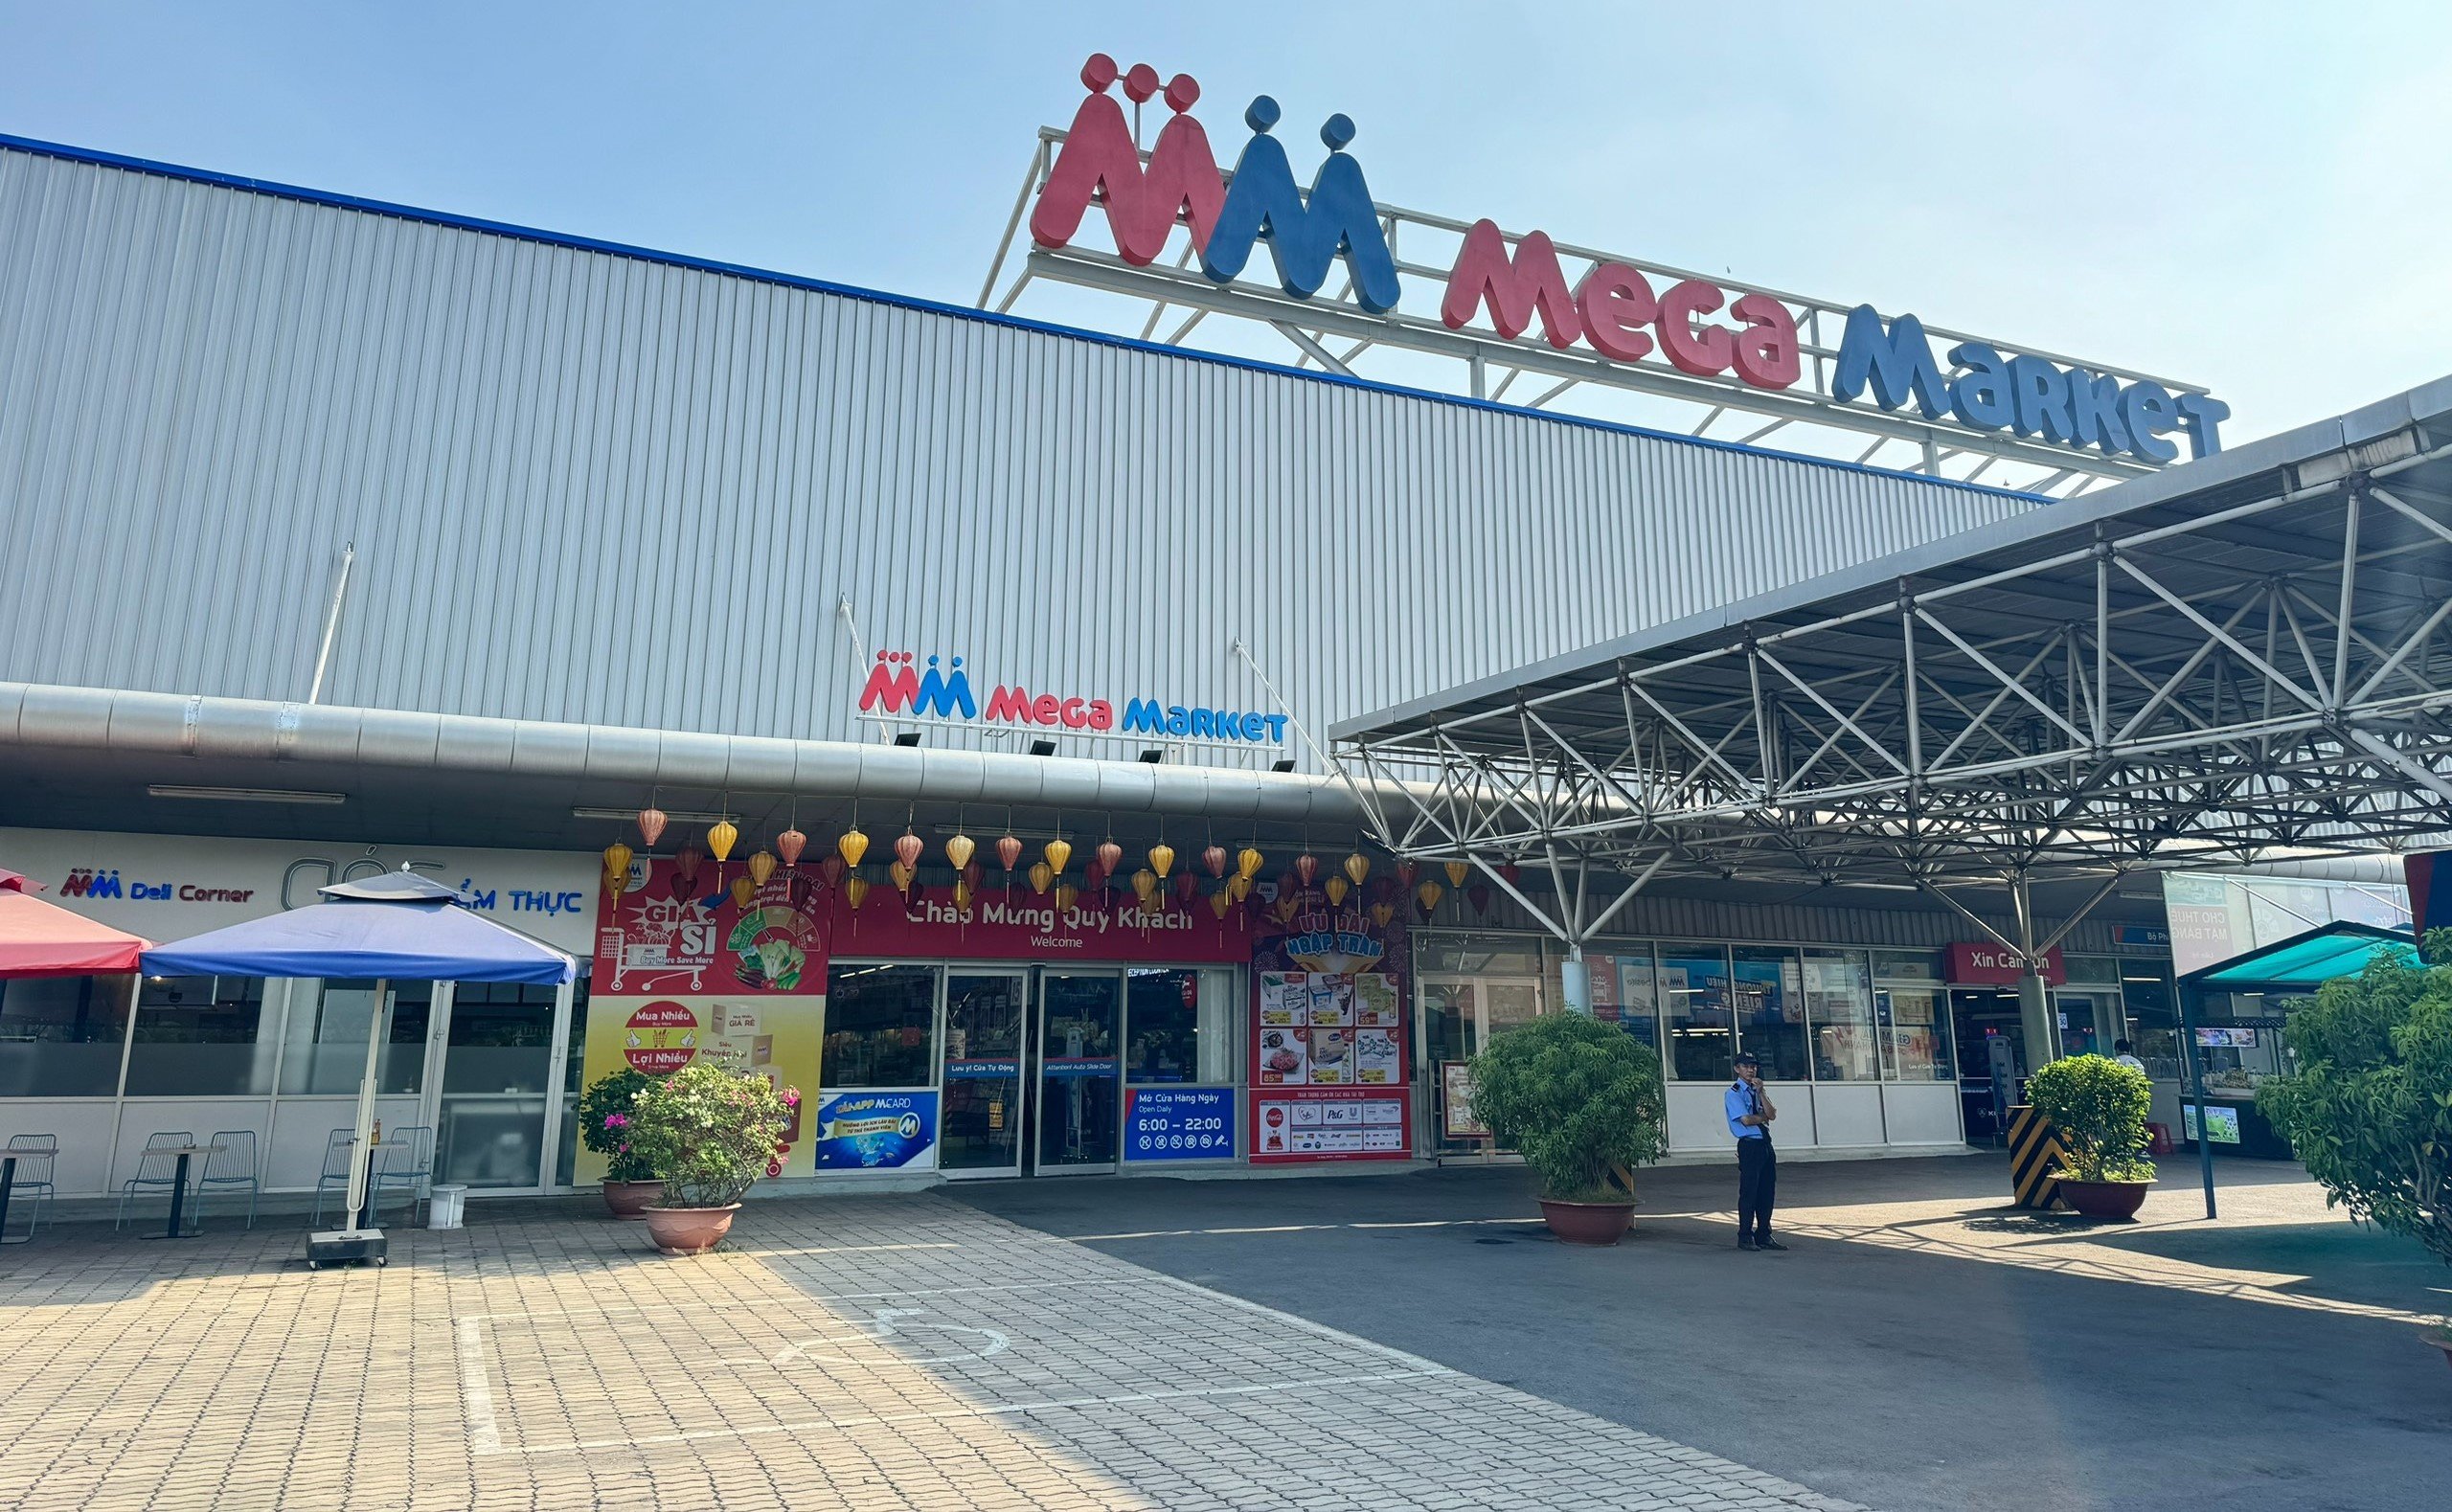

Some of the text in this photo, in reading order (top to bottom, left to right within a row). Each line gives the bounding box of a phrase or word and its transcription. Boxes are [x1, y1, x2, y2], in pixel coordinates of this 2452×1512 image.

[130, 883, 172, 901] Deli
[179, 885, 254, 903] Corner
[509, 890, 583, 917] THỰC
[644, 901, 700, 923] GIÁ
[1031, 936, 1083, 948] Welcome
[656, 956, 675, 965] More
[676, 956, 693, 964] Save
[694, 956, 714, 964] More
[1971, 952, 1994, 967] Xin
[636, 1011, 658, 1021] Mua
[632, 1052, 652, 1066] Lợi
[1138, 1093, 1219, 1105] Mở Cửa Hàng Ngày
[1138, 1105, 1155, 1115] Open
[1327, 1109, 1344, 1119] P&G
[1139, 1118, 1168, 1132] 6:00
[1185, 1117, 1221, 1131] 22:00
